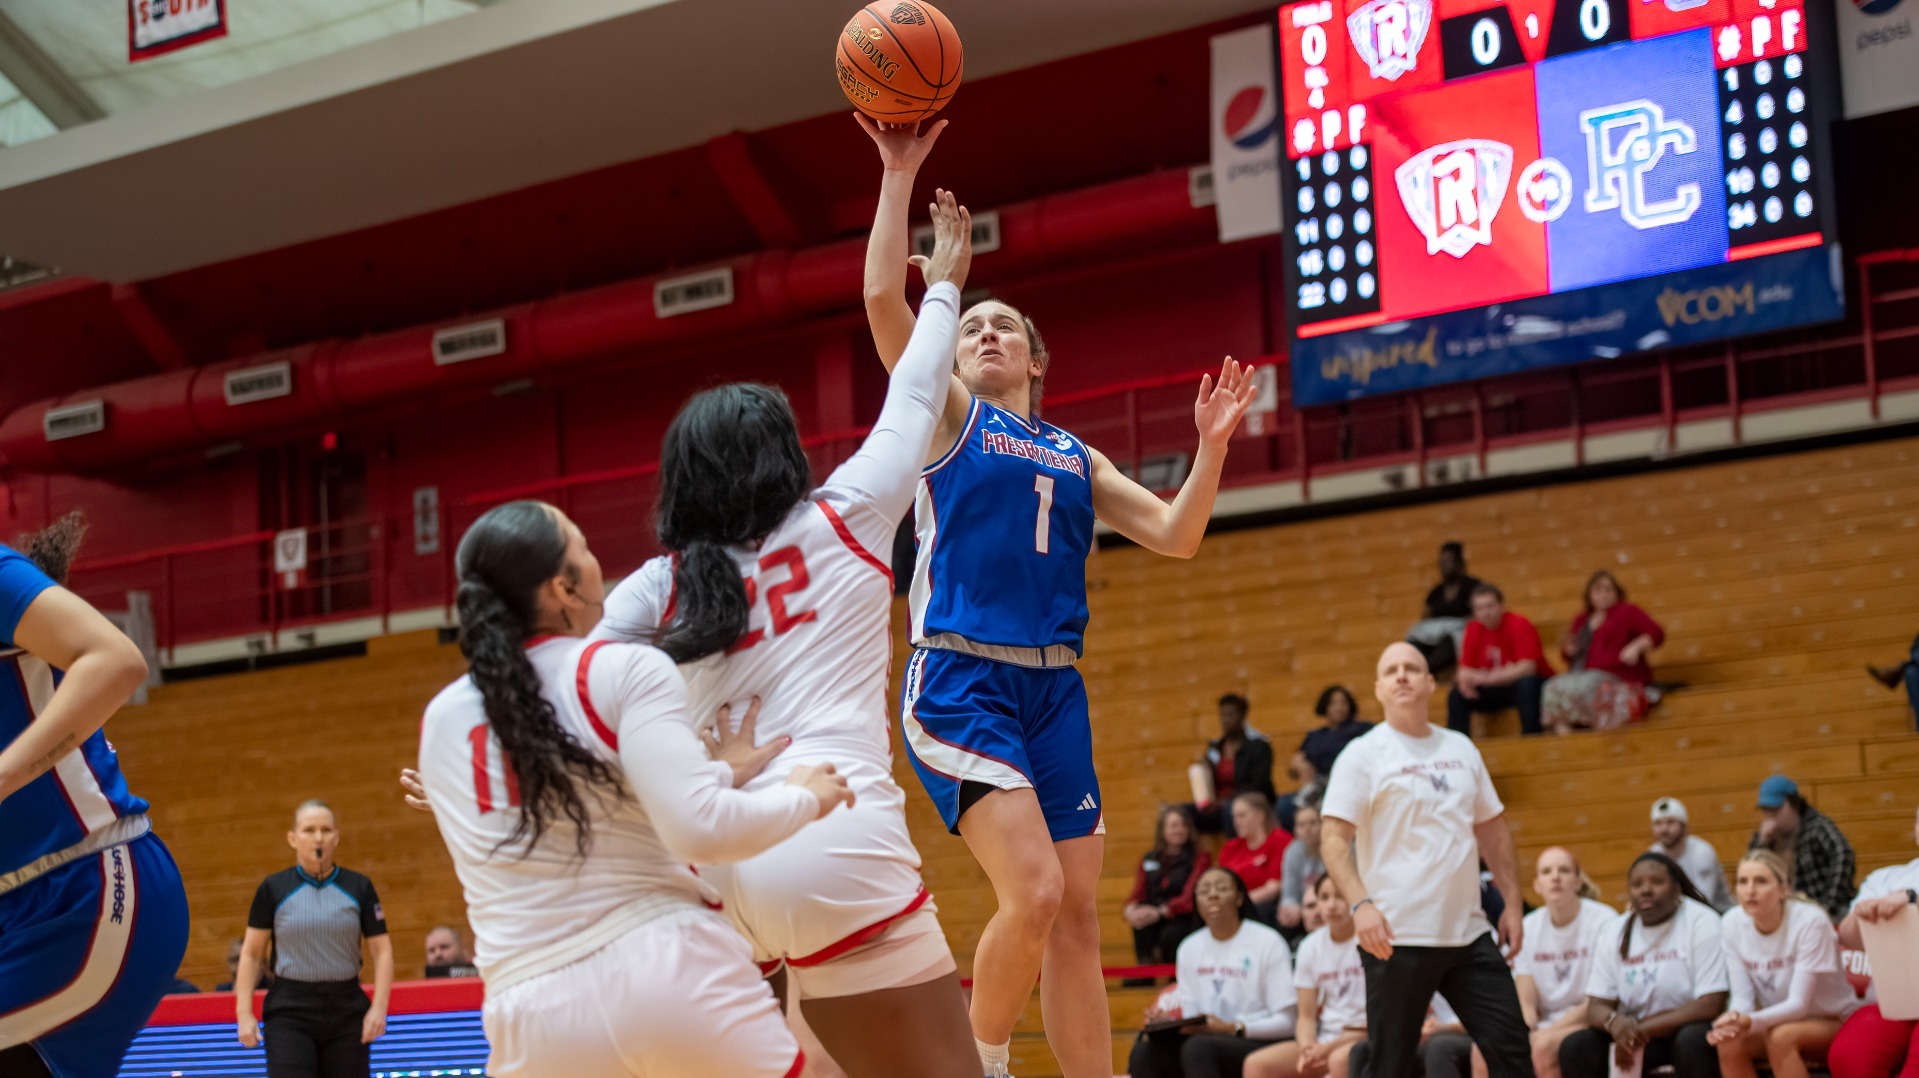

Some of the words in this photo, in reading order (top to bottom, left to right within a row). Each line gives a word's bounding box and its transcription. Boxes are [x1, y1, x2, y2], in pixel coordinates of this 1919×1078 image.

[1525, 12, 1539, 39] 1
[1580, 0, 1610, 41] 0
[1751, 15, 1772, 58] P
[1781, 9, 1800, 51] F
[845, 17, 900, 81] SPALDING
[1301, 24, 1327, 66] 0
[1471, 17, 1501, 65] 0
[1723, 66, 1739, 92] 1
[1753, 59, 1773, 86] 0
[1783, 53, 1803, 79] 0
[1756, 92, 1776, 120] 0
[1786, 86, 1805, 114] 0
[1321, 109, 1342, 150] P
[1758, 126, 1778, 155] 0
[1788, 120, 1808, 149] 0
[1295, 155, 1311, 181] 1
[1321, 150, 1341, 176] 0
[1349, 144, 1368, 171] 0
[1725, 165, 1756, 195] 10
[1761, 160, 1781, 189] 0
[1791, 154, 1811, 183] 0
[1323, 181, 1343, 209] 0
[1351, 175, 1369, 203] 0
[1763, 195, 1784, 224] 0
[1794, 189, 1814, 218] 0
[1295, 217, 1320, 246] 11
[1325, 213, 1344, 240] 0
[1353, 207, 1371, 235] 0
[1327, 244, 1346, 272] 0
[1354, 239, 1374, 267] 0
[1329, 276, 1348, 305] 0
[1356, 271, 1375, 299] 0
[981, 428, 1086, 481] PRESBYTERIA
[1034, 473, 1055, 555] 1
